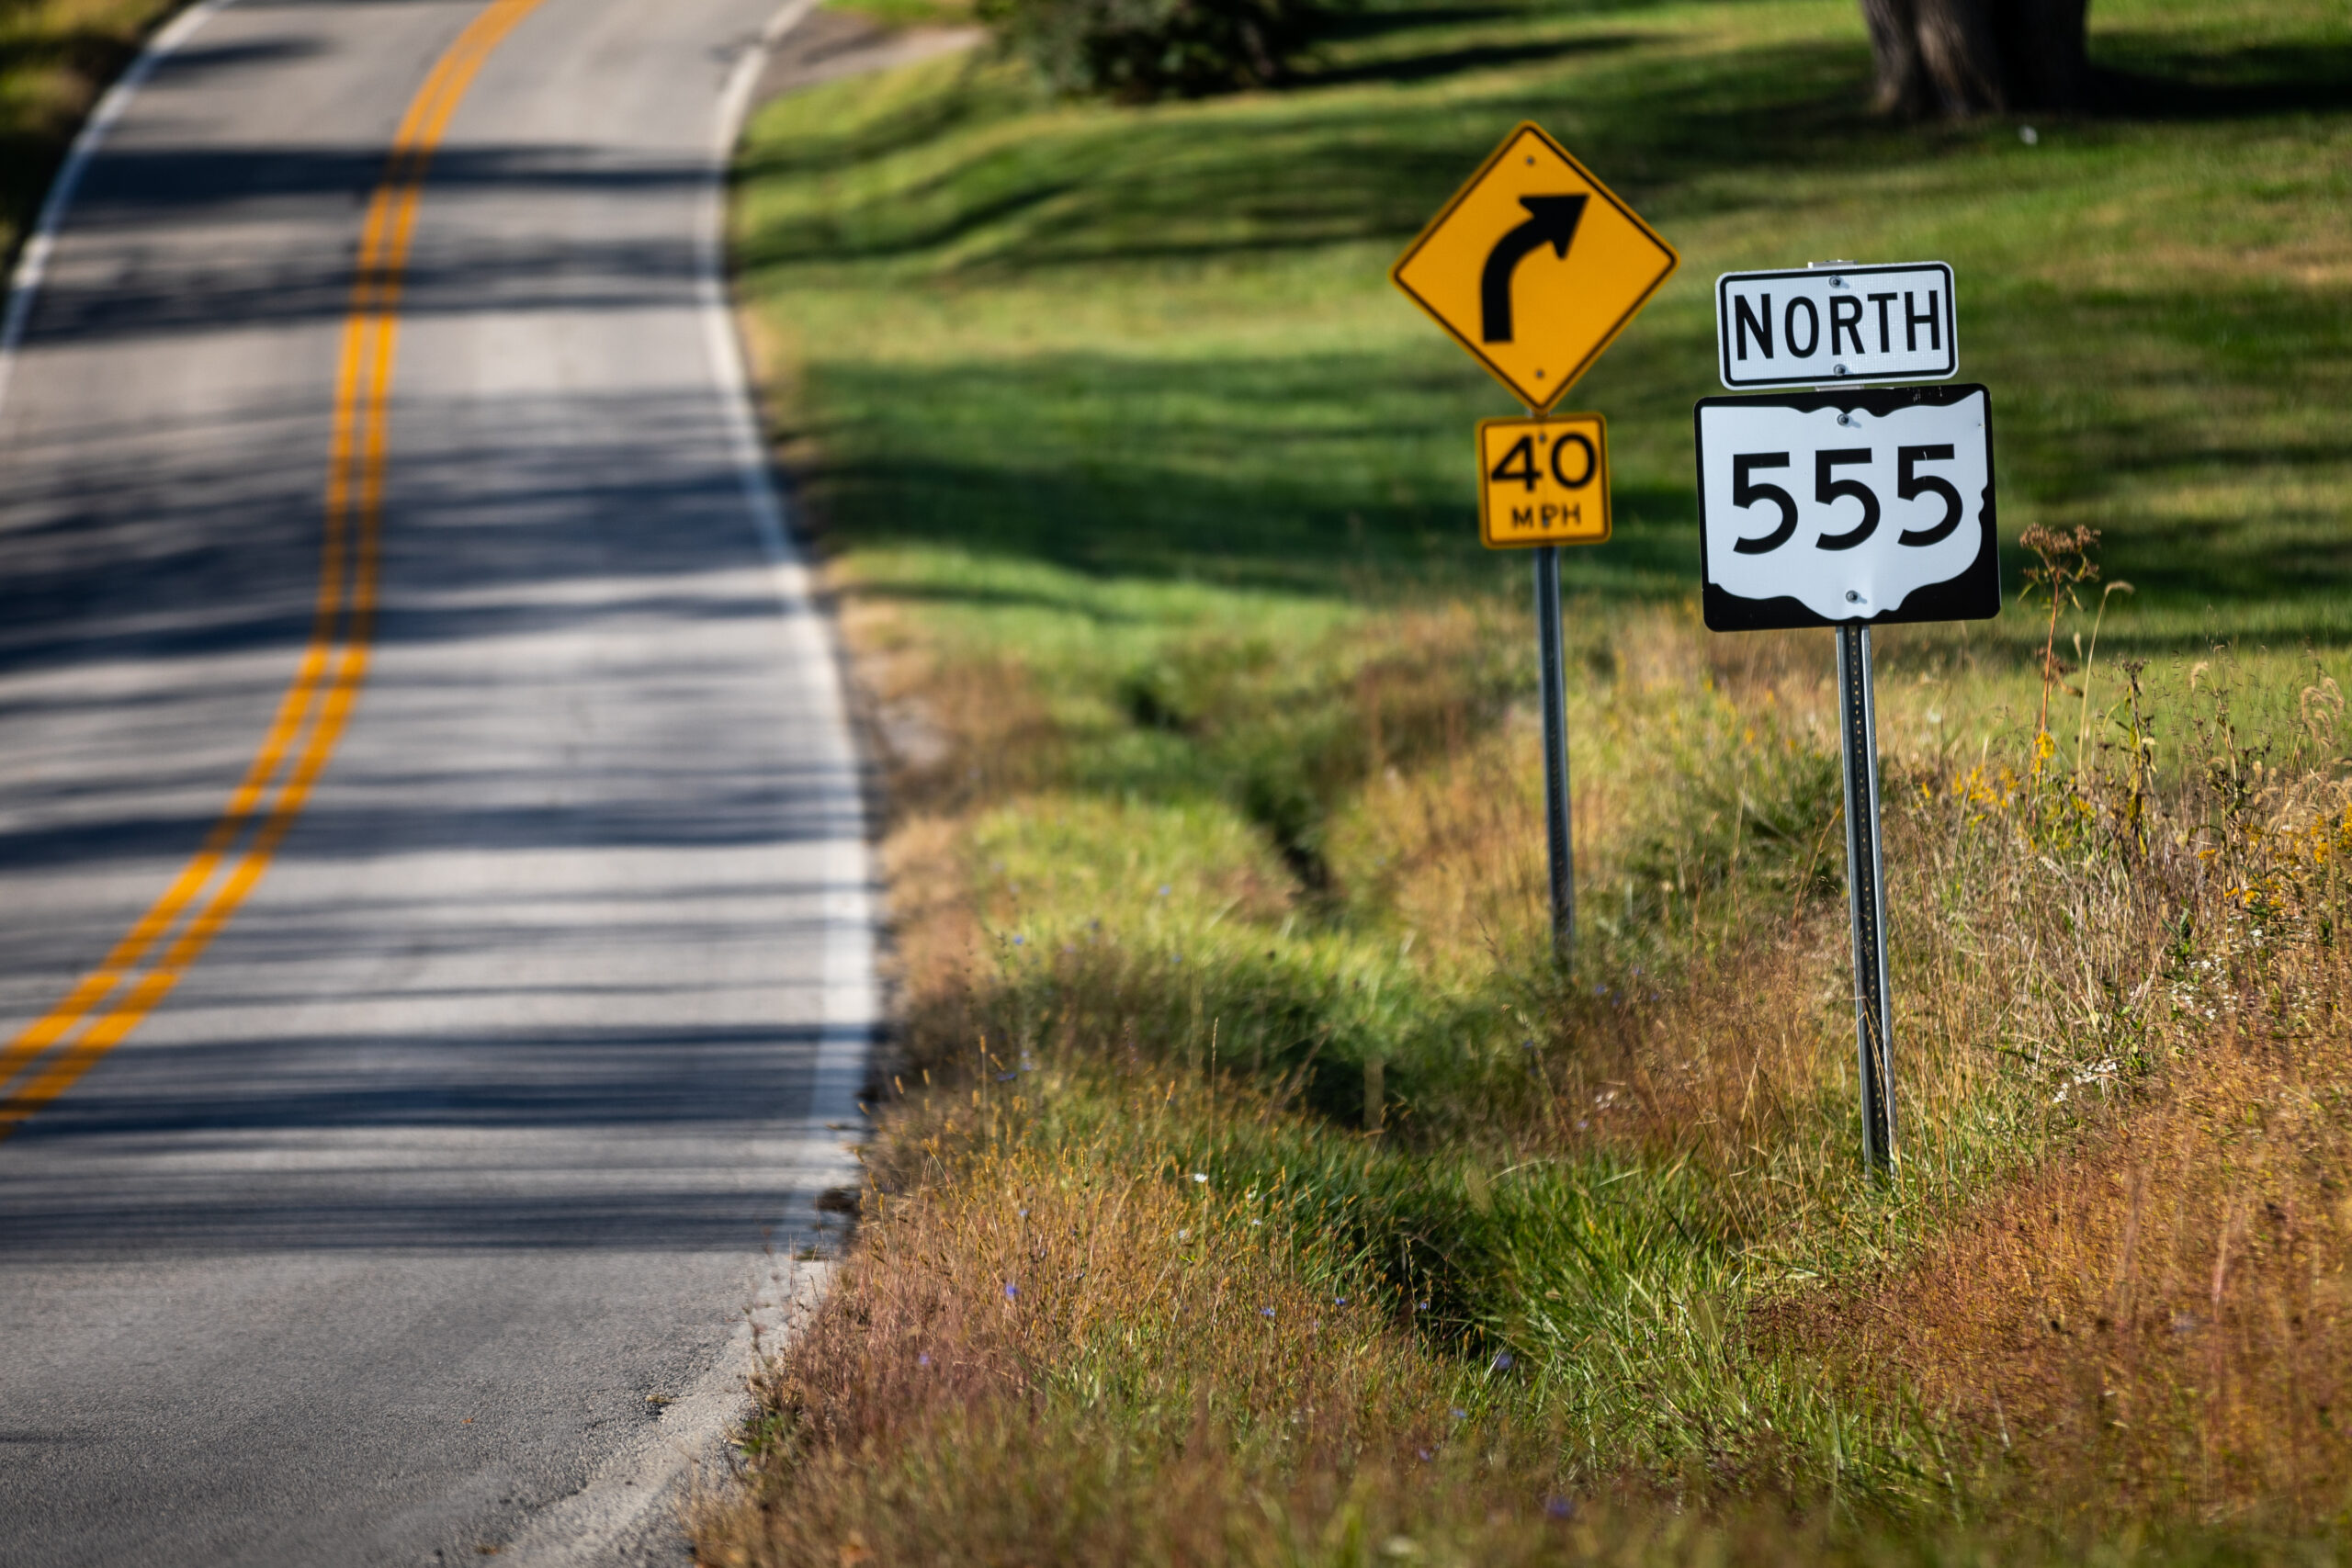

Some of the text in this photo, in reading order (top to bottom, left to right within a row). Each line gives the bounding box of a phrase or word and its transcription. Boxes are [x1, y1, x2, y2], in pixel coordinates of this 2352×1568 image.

[1734, 289, 1941, 361] NORTH
[1490, 431, 1599, 492] 40
[1510, 502, 1582, 530] MPH
[1733, 443, 1963, 555] 555
